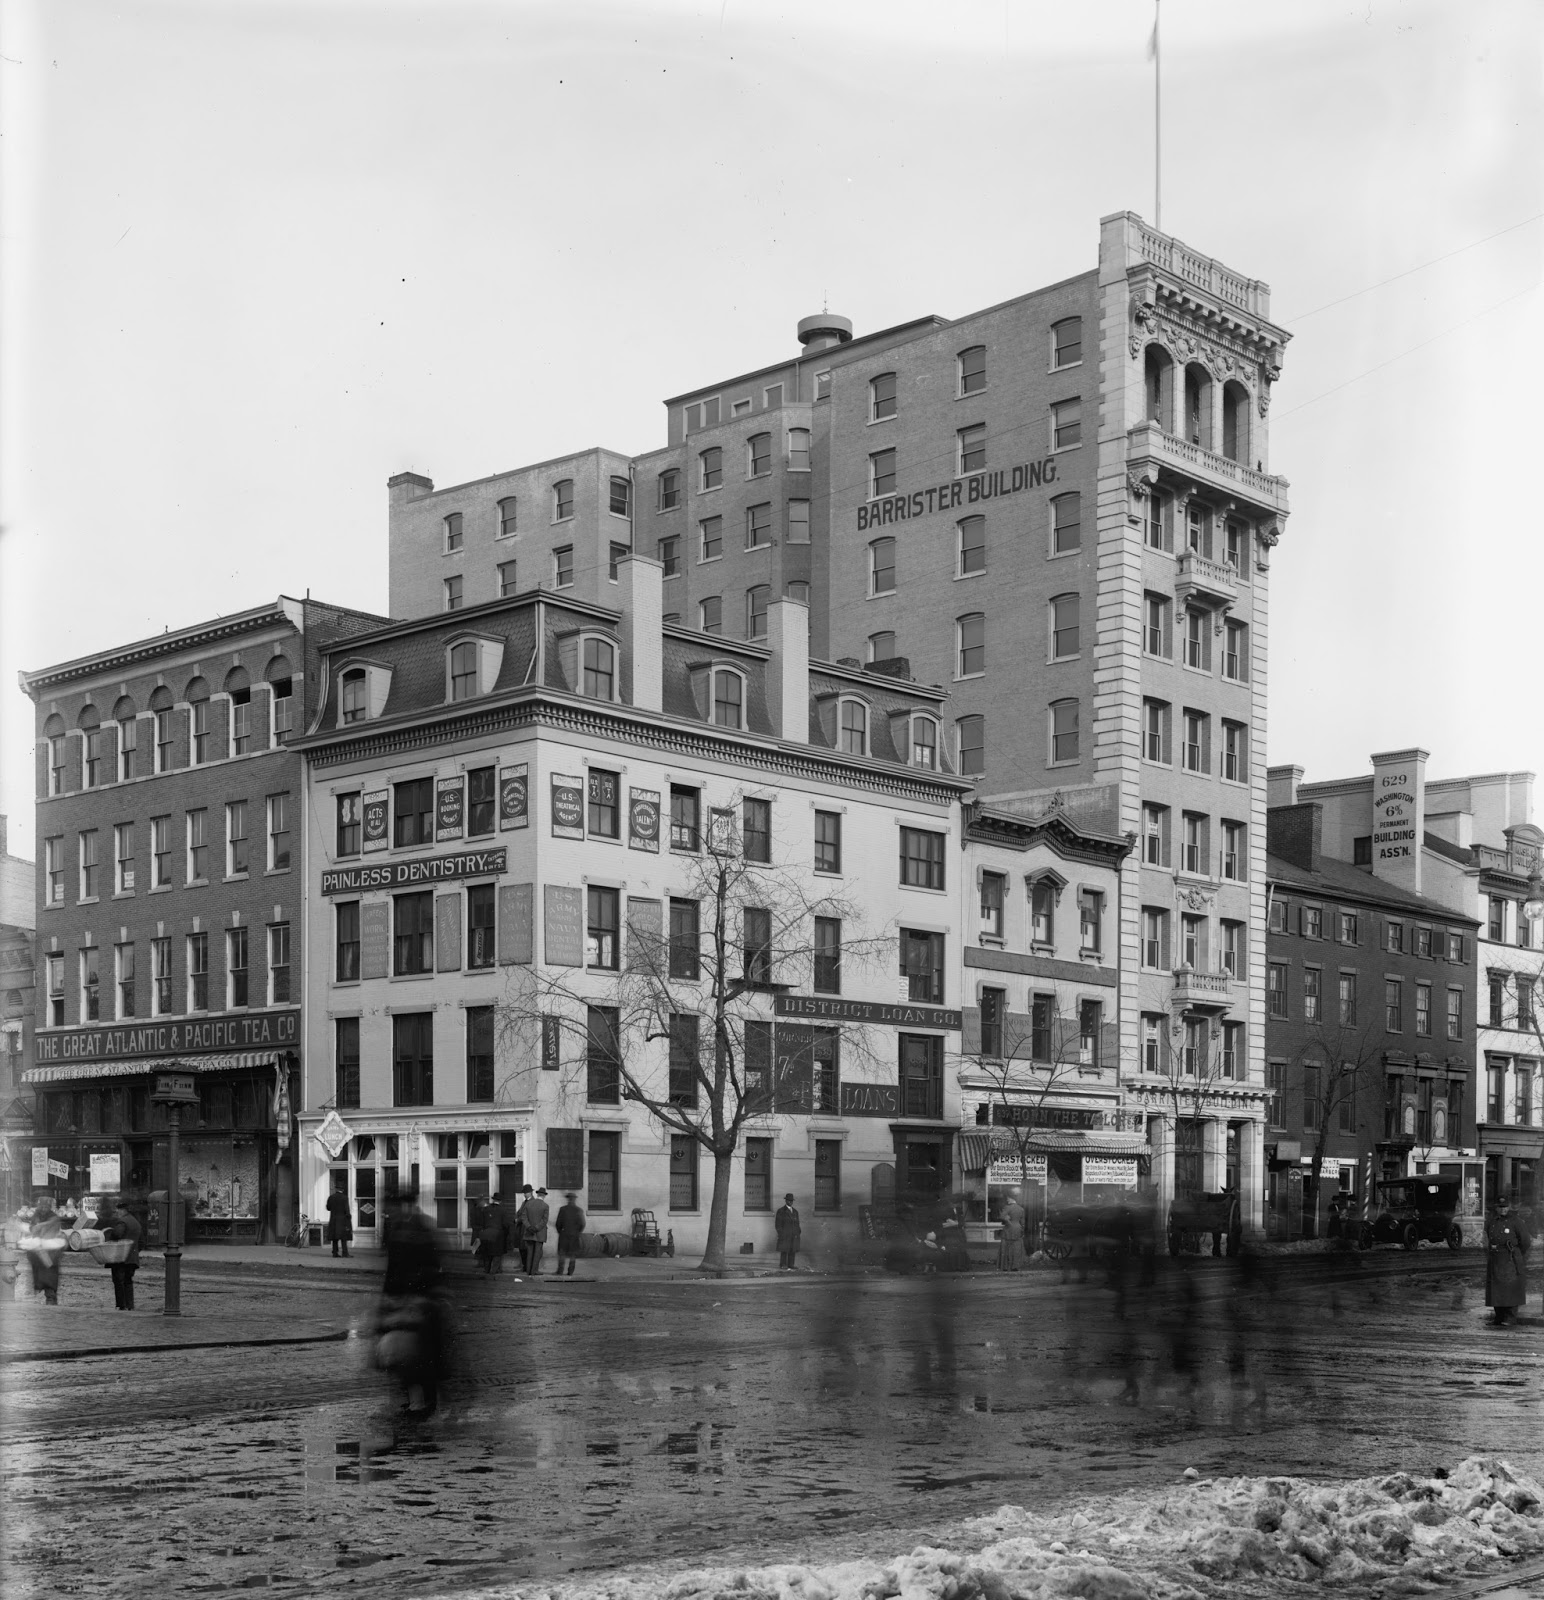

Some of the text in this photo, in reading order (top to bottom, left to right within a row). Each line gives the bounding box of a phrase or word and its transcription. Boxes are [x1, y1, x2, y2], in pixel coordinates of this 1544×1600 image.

[857, 457, 1060, 531] BARRISTER BUILDING.
[1382, 774, 1407, 788] 629
[555, 801, 580, 812] THEATRICAL
[1374, 792, 1415, 808] WASHINGTON
[367, 807, 383, 820] ACTS
[440, 803, 461, 813] BOOKING
[1385, 803, 1403, 817] 6%
[442, 812, 458, 824] AGENCY
[558, 811, 577, 821] AGENCY
[636, 815, 653, 826] TALENT
[1379, 819, 1409, 829] PERMANENT
[1374, 829, 1416, 844] BUILDING
[487, 851, 506, 862] ENTRANCE
[323, 868, 391, 891] PAINLESS
[549, 903, 580, 916] ARMY
[364, 925, 385, 934] WORK
[548, 923, 578, 933] NAVY
[548, 935, 581, 944] DENTAL
[785, 999, 958, 1025] DISTRICT LOAN CO.
[1010, 1018, 1030, 1026] HORN
[37, 1037, 59, 1059] THE
[63, 1032, 102, 1058] GREAT
[105, 1027, 166, 1054] ATLANTIC
[170, 1026, 180, 1049] &
[185, 1022, 237, 1049] PACIFIC
[242, 1018, 271, 1043] TEA
[76, 1067, 103, 1077] GREAT
[107, 1063, 146, 1074] ATLANTIC
[844, 1087, 897, 1112] LOANS
[1136, 1092, 1255, 1110] BARRISTER BUILDING
[1012, 1107, 1048, 1124] HORN
[1054, 1110, 1078, 1125] THE
[1084, 1112, 1126, 1128] TAILOR
[324, 1133, 343, 1141] LUNCH
[1085, 1156, 1136, 1165] OVERSTOCKED
